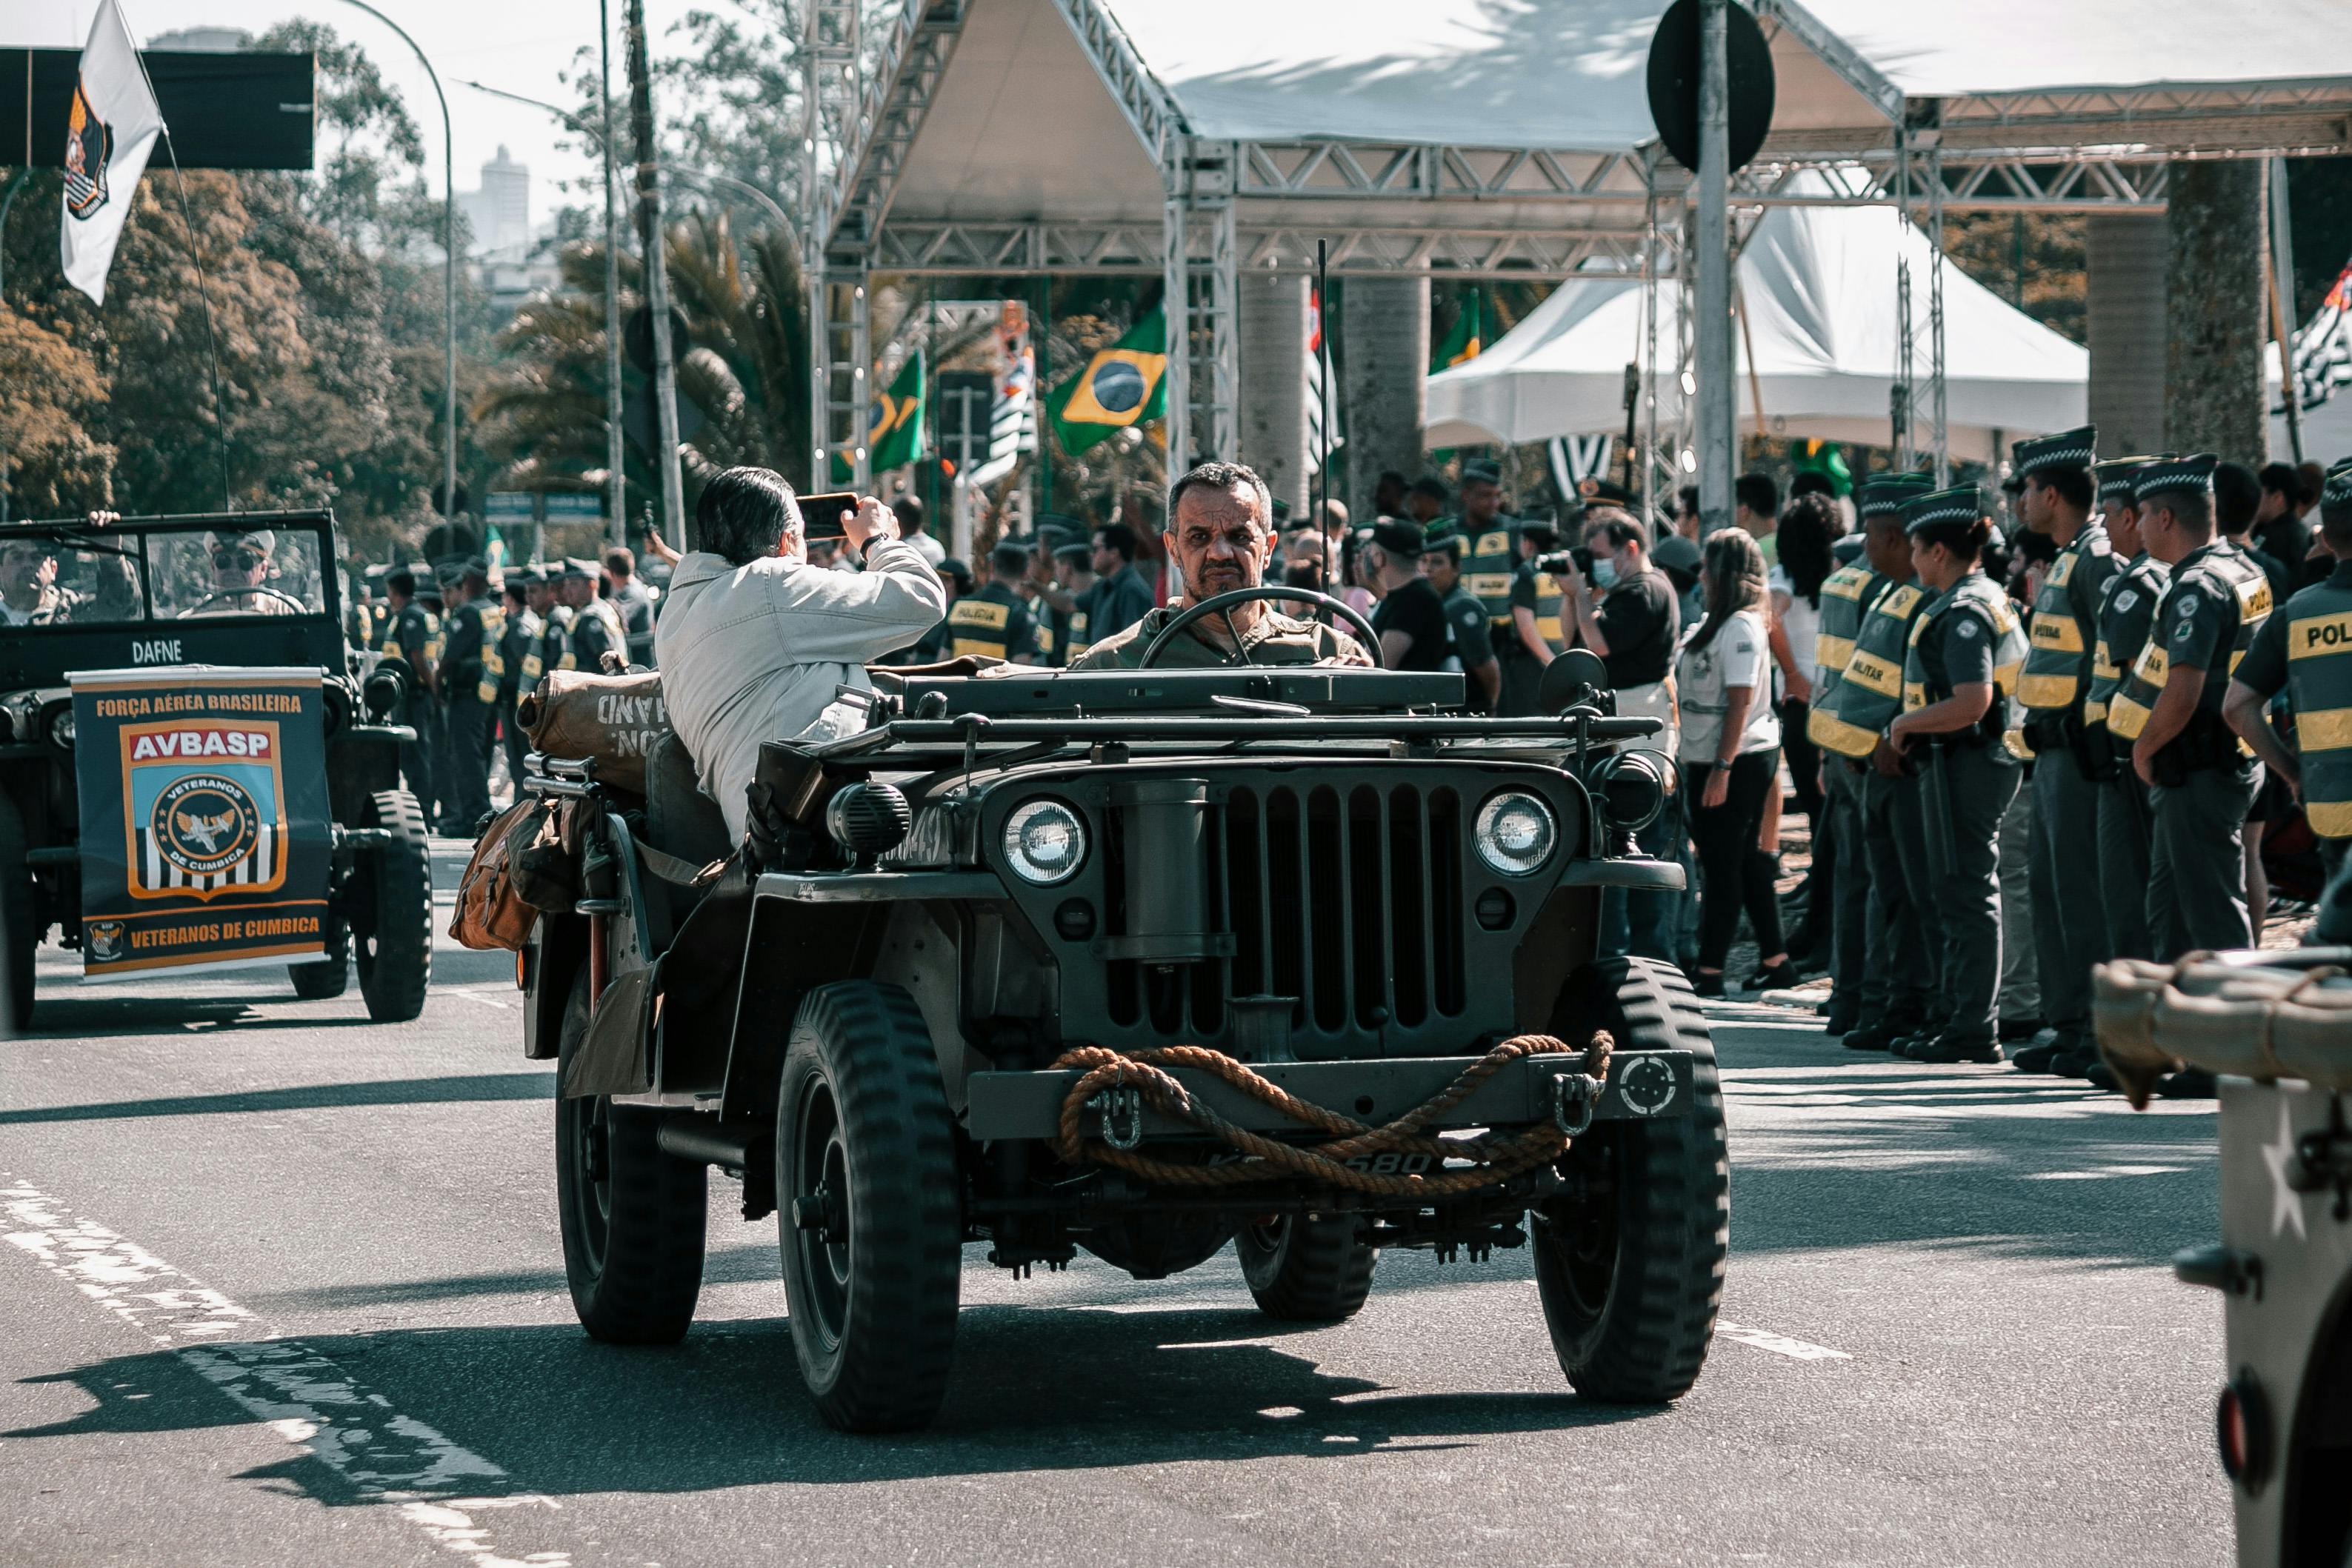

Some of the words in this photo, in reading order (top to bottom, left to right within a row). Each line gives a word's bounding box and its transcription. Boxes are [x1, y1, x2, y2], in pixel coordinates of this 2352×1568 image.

[133, 639, 182, 664] DAFNE
[96, 698, 151, 718] FORÇA
[153, 693, 204, 713] AÉREA
[207, 694, 302, 714] BRASILEIRA
[133, 731, 269, 760] AVBASP
[167, 778, 243, 800] VETERANOS
[170, 851, 187, 867] DE
[189, 848, 245, 870] CUMBICA
[131, 924, 220, 949] VETERANOS
[223, 921, 241, 939] DE
[245, 916, 319, 937] CUMBICA
